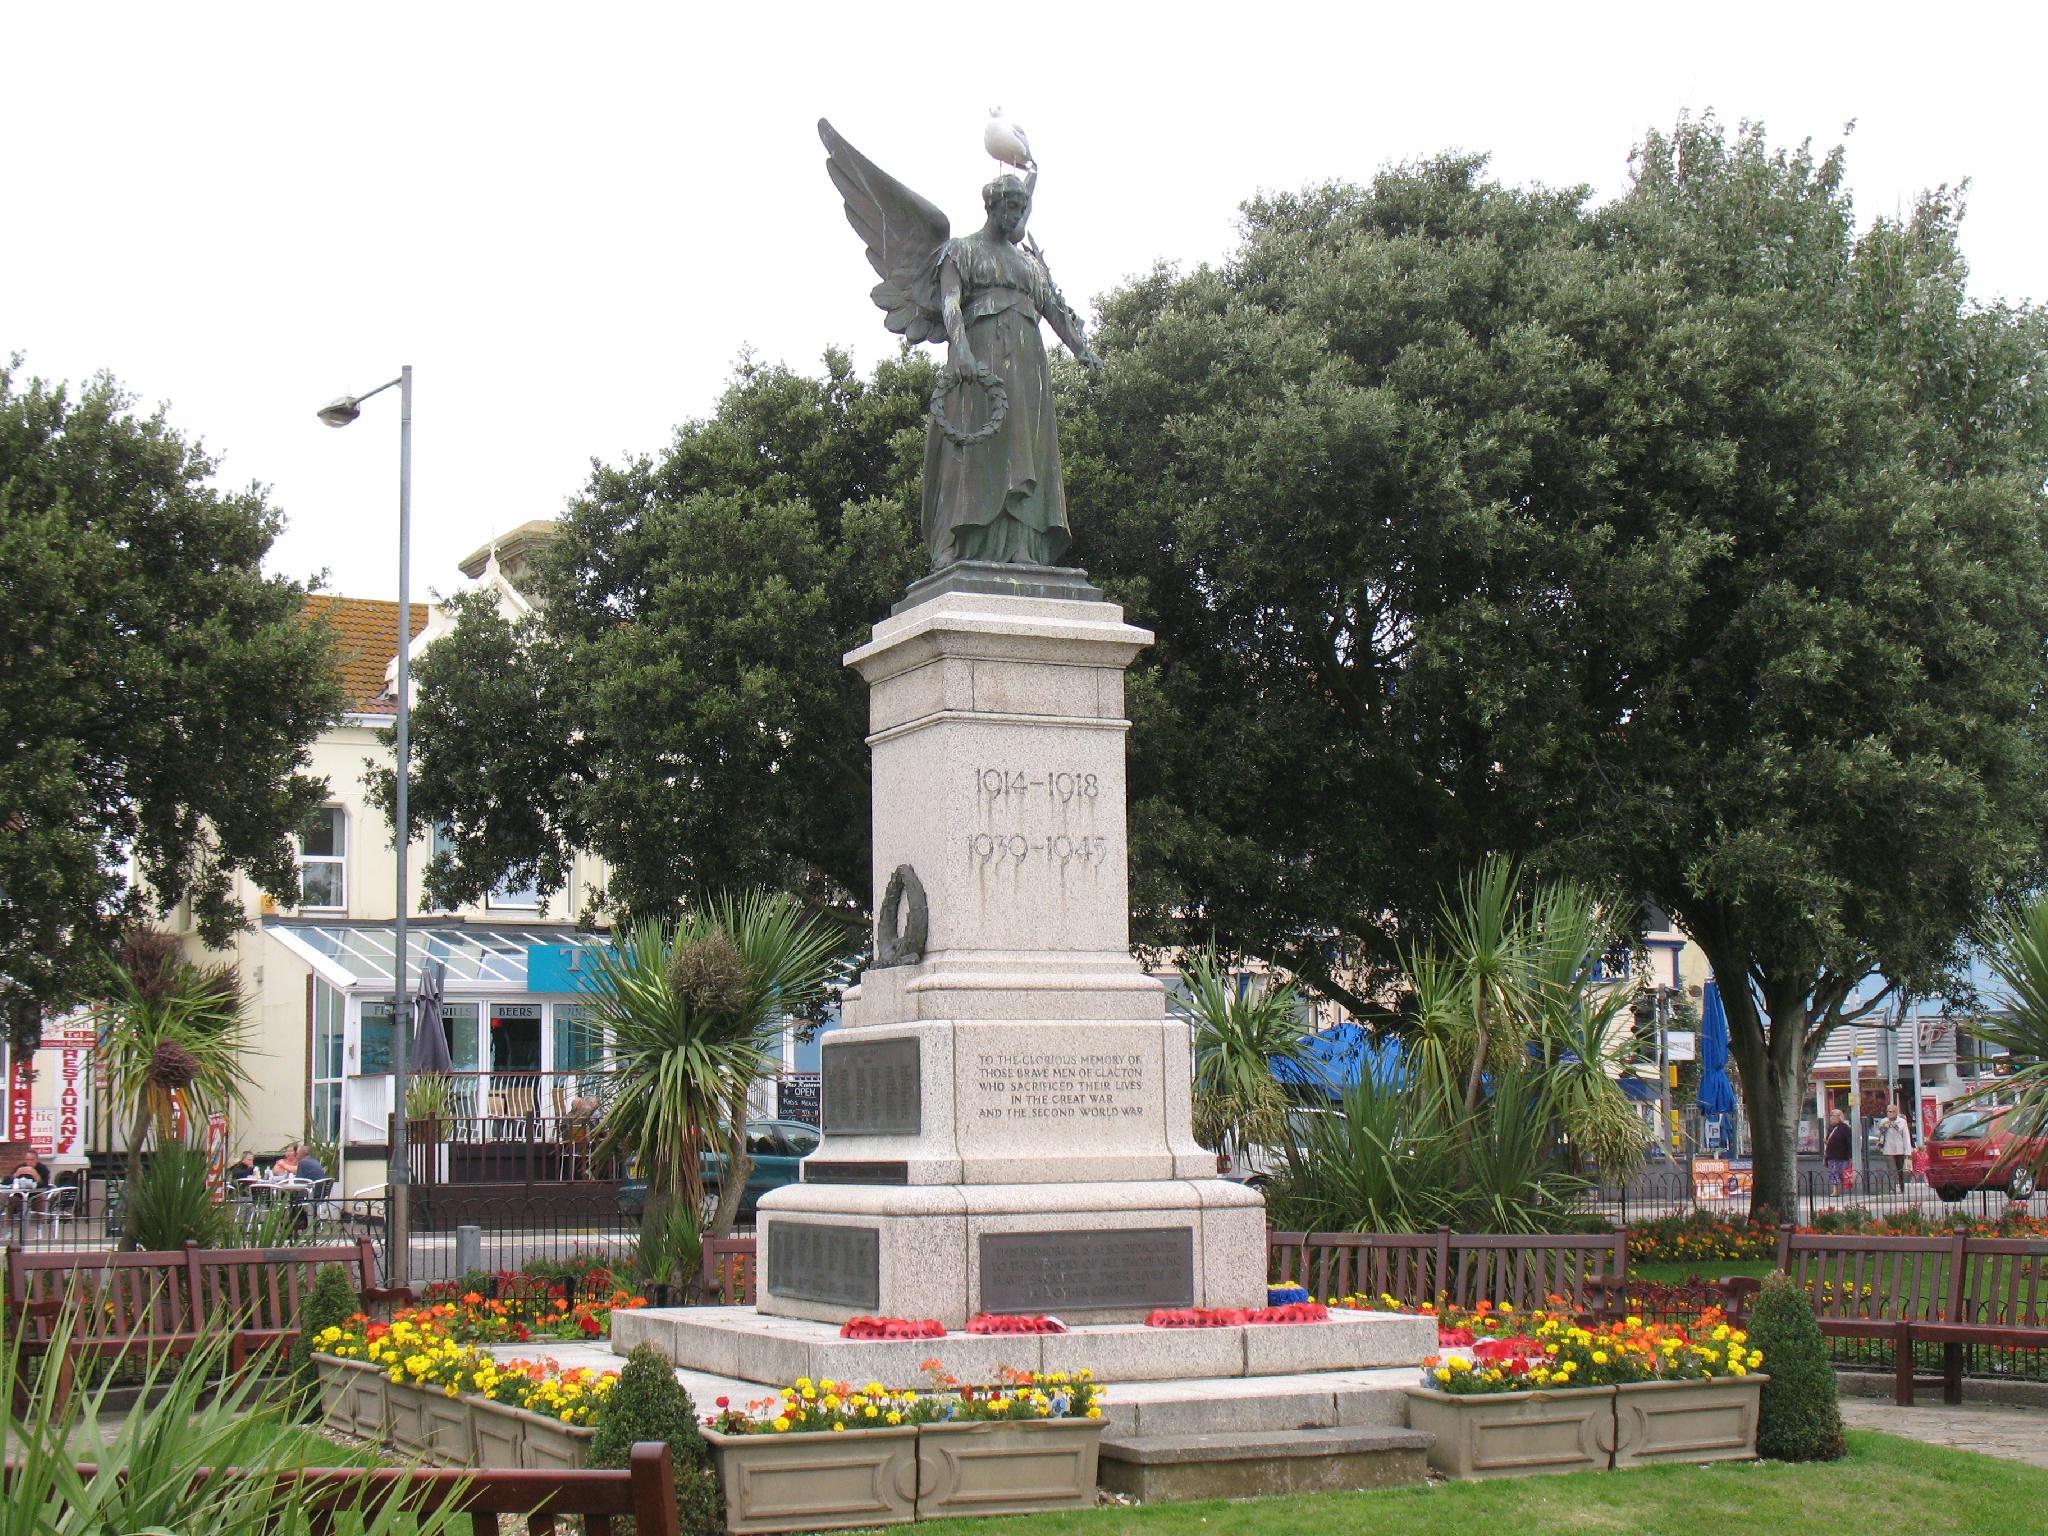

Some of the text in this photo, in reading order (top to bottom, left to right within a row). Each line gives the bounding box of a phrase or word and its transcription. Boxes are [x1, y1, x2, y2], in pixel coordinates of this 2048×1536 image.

[977, 769, 1099, 804] 1914-1918
[499, 1007, 533, 1017] BEERS
[979, 1055, 1141, 1065] TO THE GLORIOUS MEMORY OF
[979, 1068, 1142, 1078] THOSE BRAVE MEN OF CLACTON
[794, 1087, 816, 1096] OPEN
[979, 1082, 1142, 1091] WHO SACRIFICED THEIR LIVES
[1011, 1095, 1114, 1104] IN THE GREAT WAR
[979, 1108, 1143, 1118] AND THE SECOND WORLD WAR
[14, 1100, 28, 1140] CHIPS
